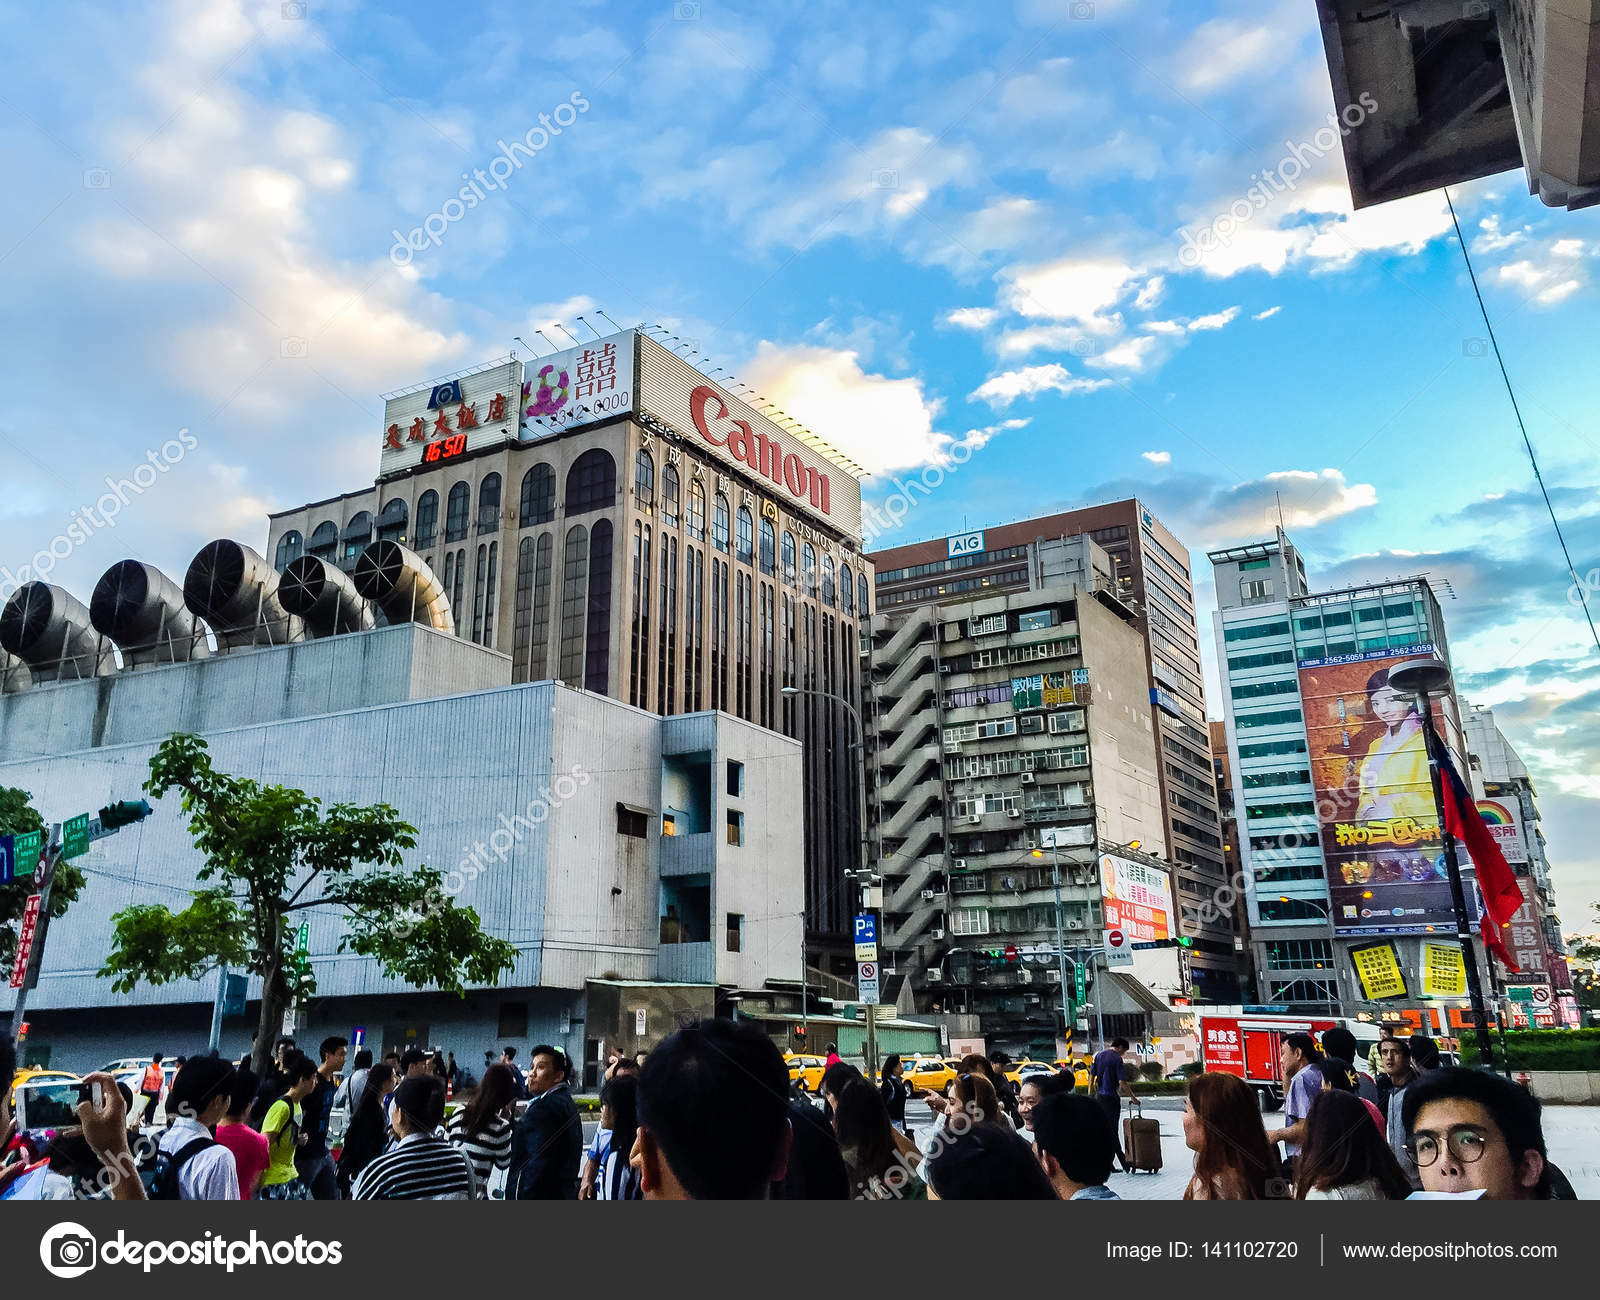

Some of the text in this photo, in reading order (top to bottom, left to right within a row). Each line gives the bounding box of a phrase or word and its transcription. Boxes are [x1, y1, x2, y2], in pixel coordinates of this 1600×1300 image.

[642, 428, 754, 509] 天成大飯店
[690, 386, 831, 515] Canon
[787, 516, 867, 573] COSMOS HOTEL
[952, 536, 979, 553] AIG
[1324, 653, 1364, 664] 2562-5059
[1390, 644, 1432, 656] 2562-5059
[855, 919, 866, 936] P
